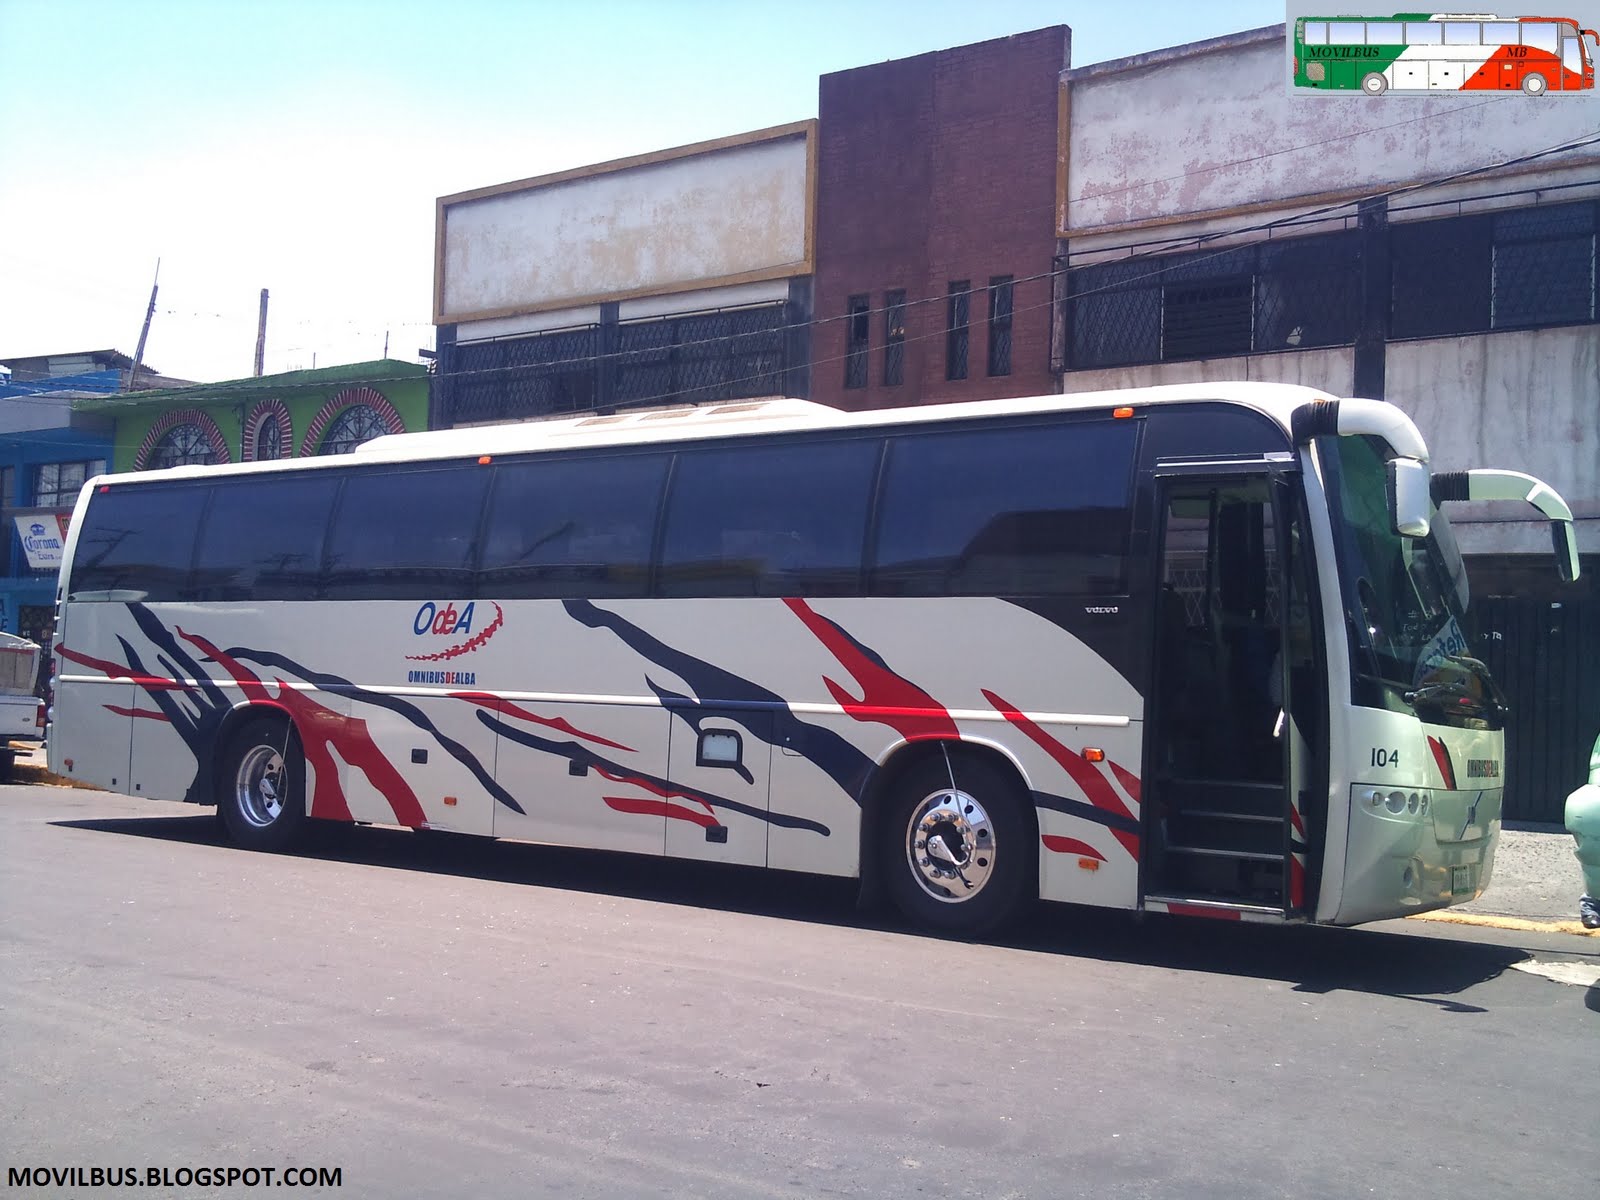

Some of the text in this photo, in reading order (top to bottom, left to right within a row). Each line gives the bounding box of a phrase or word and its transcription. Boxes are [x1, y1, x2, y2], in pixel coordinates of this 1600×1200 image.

[25, 536, 60, 552] Corona
[408, 671, 475, 685] OMNIBUSDEALBA
[1371, 748, 1399, 767] 104
